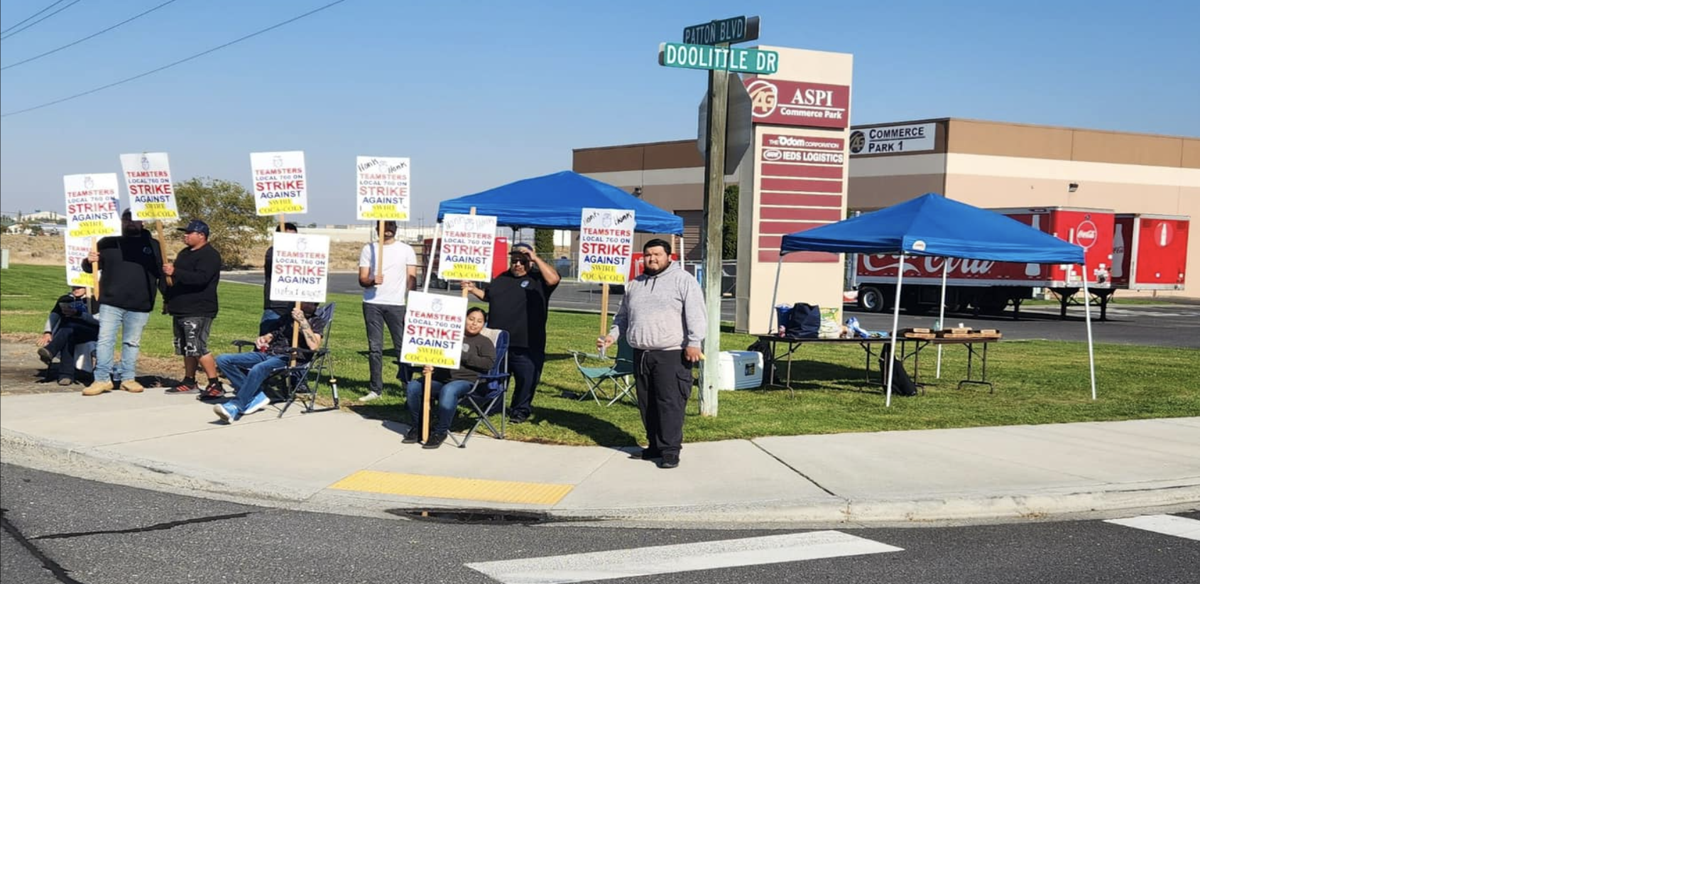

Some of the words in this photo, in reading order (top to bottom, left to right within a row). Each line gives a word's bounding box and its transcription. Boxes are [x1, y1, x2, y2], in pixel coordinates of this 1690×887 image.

[685, 24, 716, 44] PATTON
[720, 19, 743, 40] BLVD
[667, 45, 748, 69] DOOLITTLE
[757, 52, 776, 72] DR
[791, 88, 833, 106] ASPI
[780, 108, 822, 118] Commerce
[825, 110, 842, 119] Park
[869, 127, 924, 139] COMMERCE
[778, 136, 805, 147] Odom
[869, 143, 894, 152] PARK
[898, 141, 903, 150] 1
[803, 152, 843, 162] LOGISTICS
[130, 184, 172, 195] STRIKE
[256, 180, 304, 191] STRIKE
[360, 186, 407, 196] STRIKE
[67, 189, 115, 198] TEAMSTERS
[68, 202, 117, 214] STRIKE
[72, 212, 114, 222] AGAINST
[445, 231, 492, 239] TEAMSTERS
[583, 228, 631, 236] TEAMSTERS
[443, 244, 491, 256] STRIKE
[582, 242, 630, 256] STRIKE
[445, 255, 487, 264] AGAINST
[584, 255, 626, 265] AGAINST
[275, 264, 326, 276] STRIKE
[277, 276, 321, 284] AGAINST
[409, 310, 462, 323] TEAMSTERS
[407, 324, 461, 341] STRIKE
[409, 337, 455, 349] AGAINST
